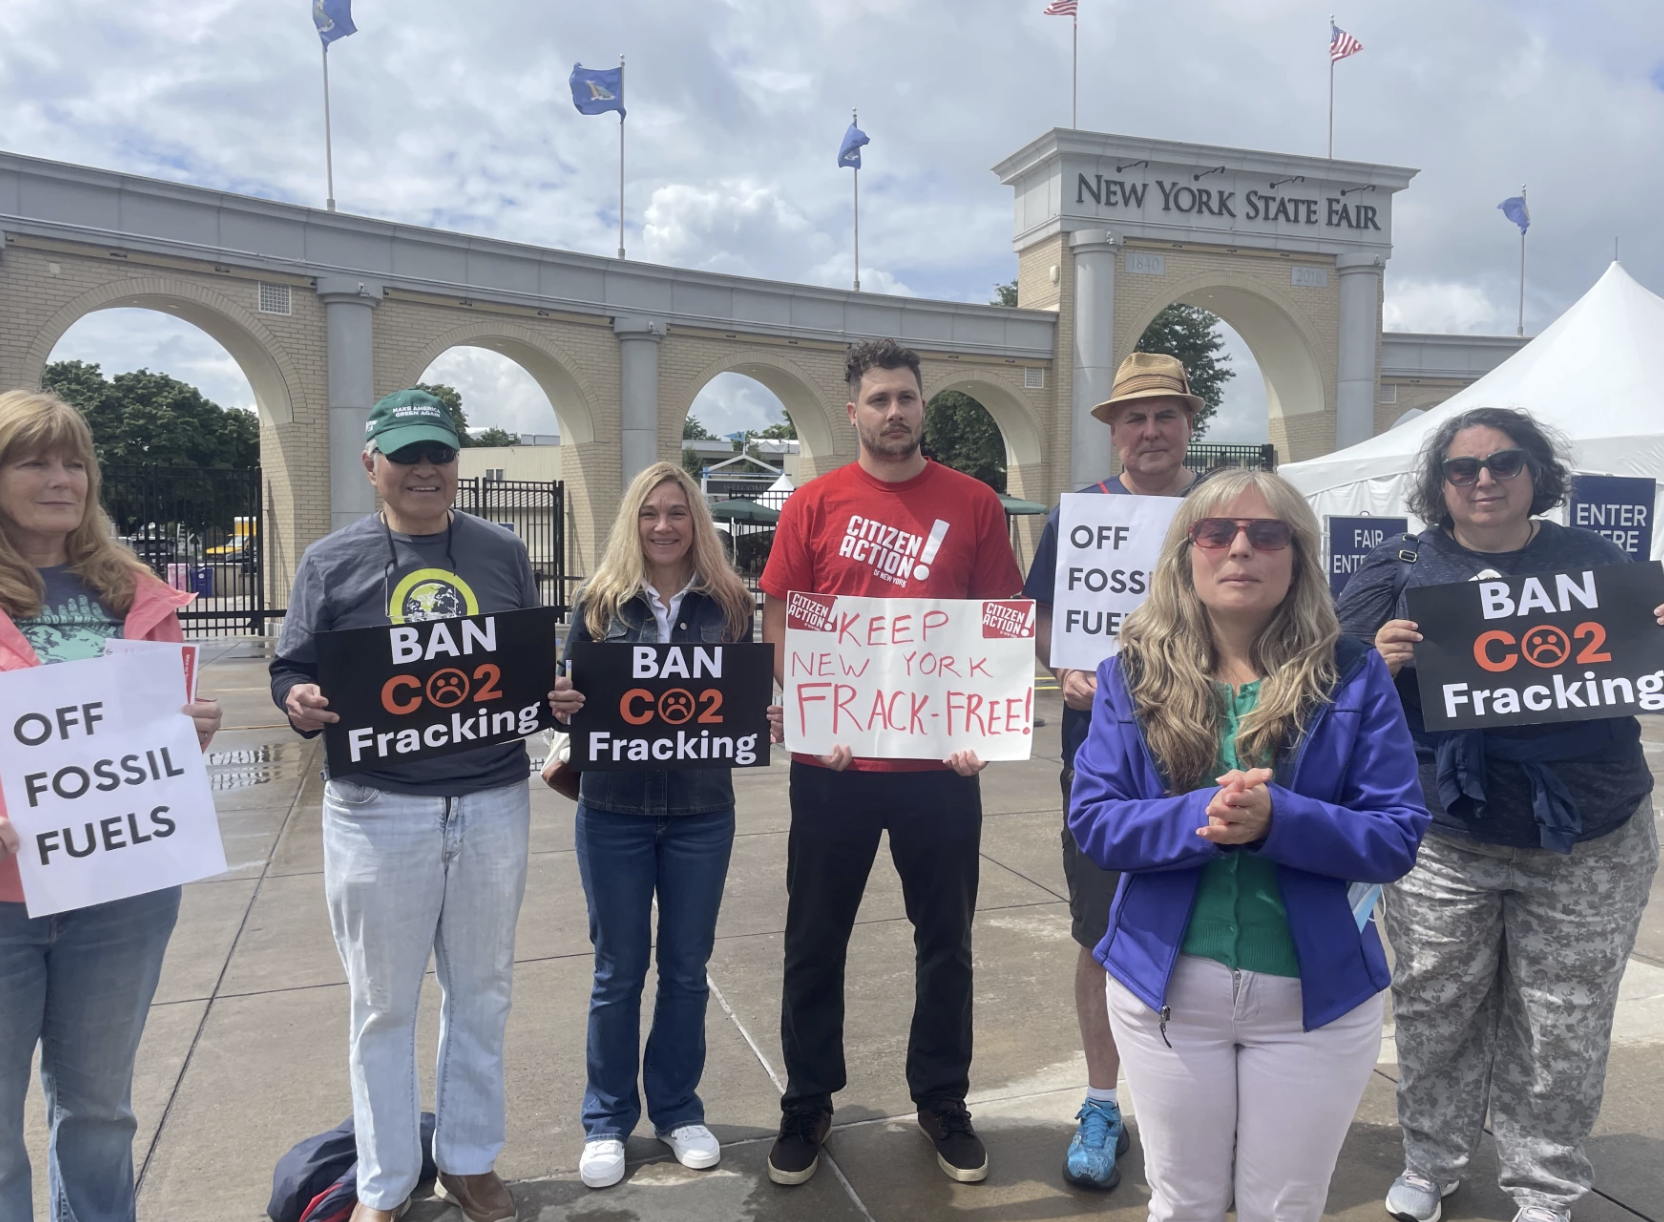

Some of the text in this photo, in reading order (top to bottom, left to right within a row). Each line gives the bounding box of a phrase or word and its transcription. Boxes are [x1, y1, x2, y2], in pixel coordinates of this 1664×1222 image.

[1076, 172, 1382, 231] NEW YORK STATE FAIR
[1131, 256, 1160, 271] 1840
[392, 405, 412, 414] MAKE
[1576, 503, 1647, 527] ENTER
[846, 515, 923, 557] CITIZEN
[1070, 525, 1130, 550] OFF
[1354, 529, 1384, 548] FAIR
[1594, 530, 1640, 553] RE
[1068, 567, 1153, 594] FOSS
[1478, 570, 1599, 620] BAN
[792, 593, 829, 618] CITIZEN
[986, 602, 1026, 624] CITIZEN
[838, 610, 950, 647] KEEP
[1065, 609, 1130, 636] FUE
[389, 616, 497, 665] BAN
[632, 646, 723, 679] BAN
[791, 650, 994, 678] NEW YORK
[1442, 670, 1664, 718] Fracking
[13, 701, 104, 746] OFF
[348, 701, 541, 763] Fracking
[588, 730, 758, 765] Fracking
[24, 746, 185, 808] FOSSIL
[36, 805, 177, 866] FUELS
